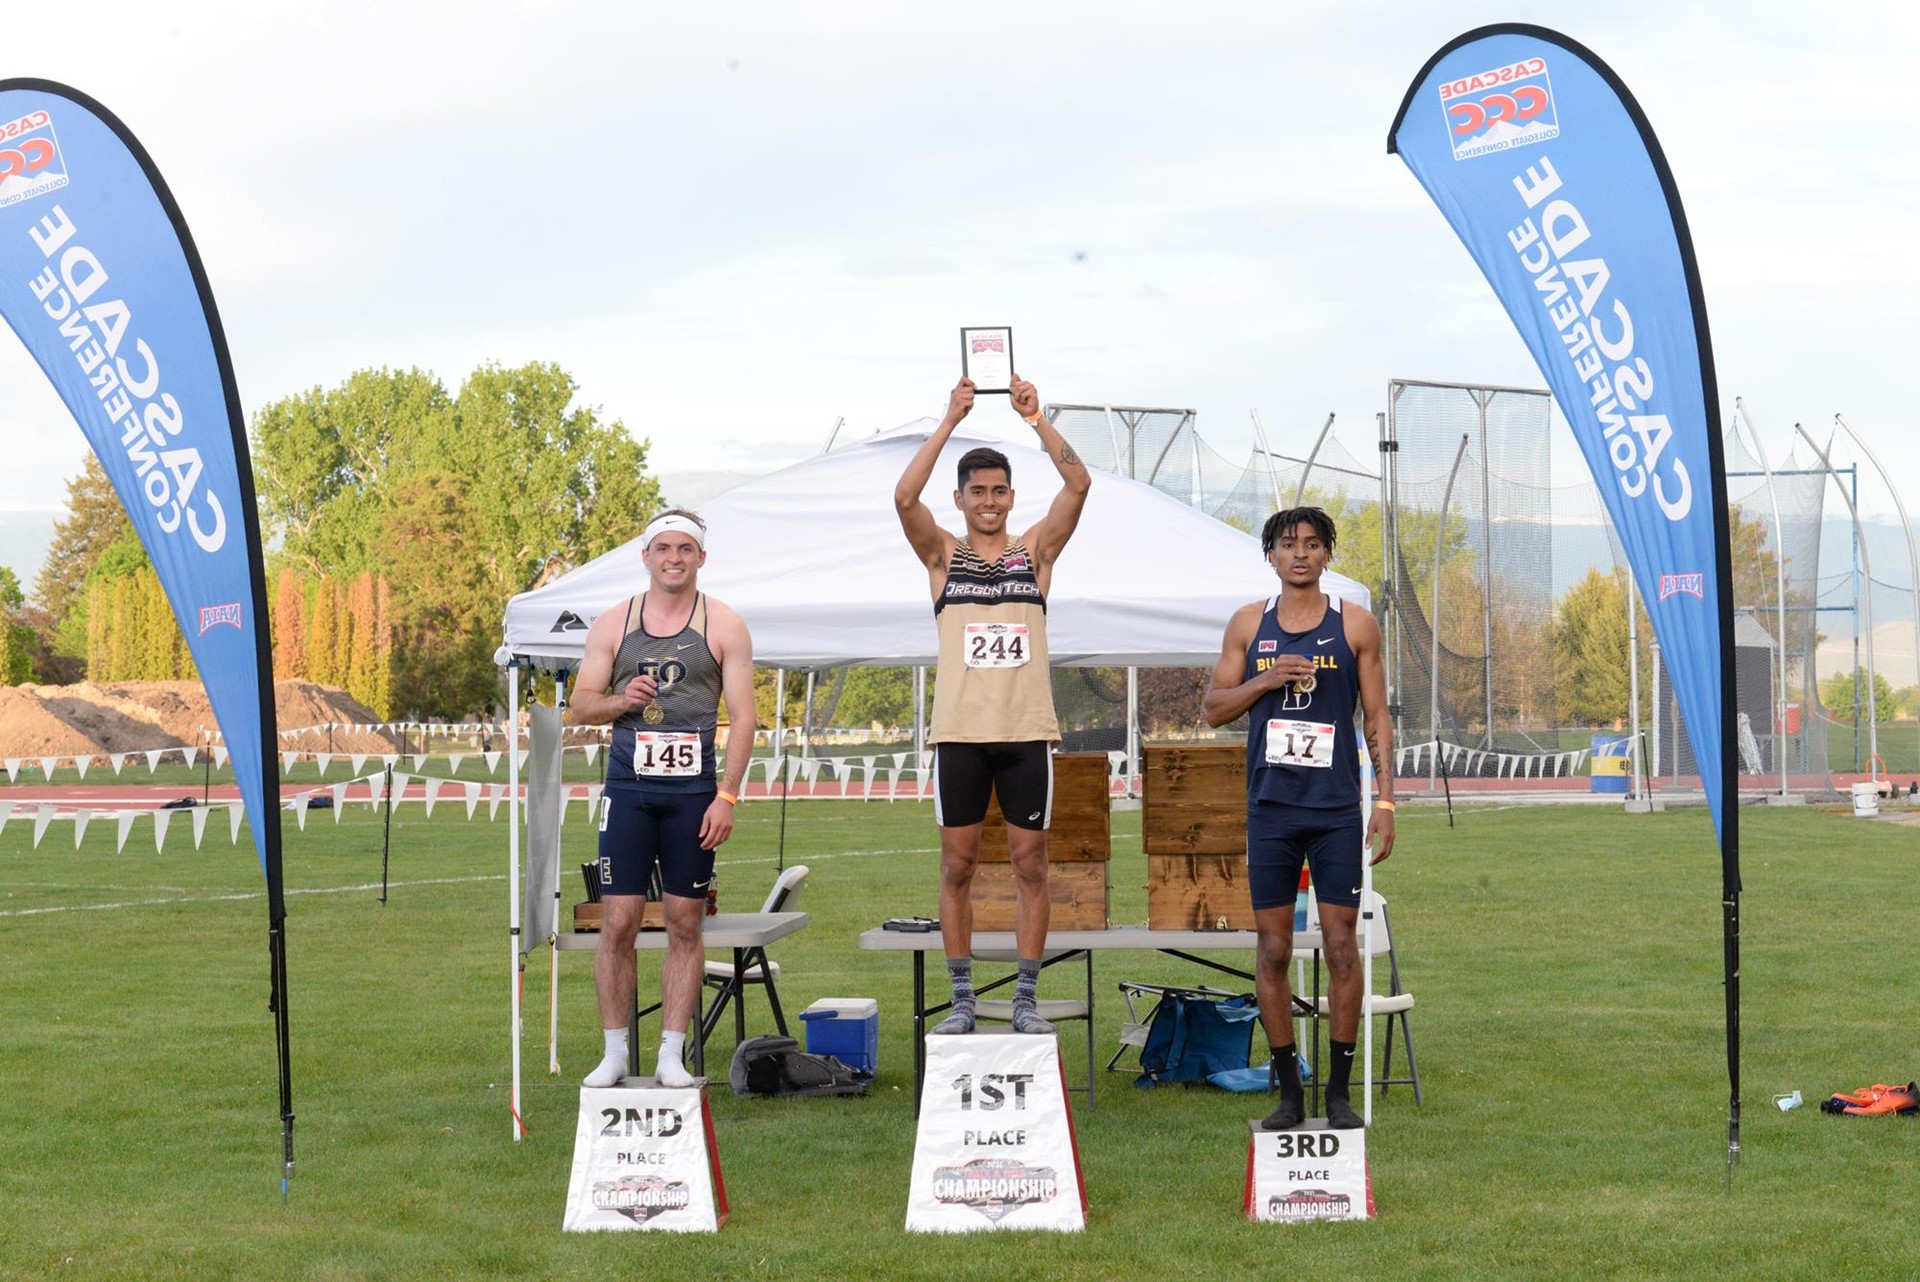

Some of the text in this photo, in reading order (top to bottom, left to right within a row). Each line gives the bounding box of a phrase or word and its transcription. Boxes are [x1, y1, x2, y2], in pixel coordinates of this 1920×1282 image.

[1003, 581, 1039, 596] TECH
[972, 636, 1023, 659] 244
[1256, 655, 1338, 672] BUELL
[1284, 733, 1317, 758] 17
[643, 744, 694, 767] 145
[951, 1073, 1034, 1111] 1ST
[600, 1107, 683, 1138] 2ND
[963, 1129, 1026, 1146] PLACE
[1277, 1133, 1340, 1158] 3RD
[616, 1152, 666, 1165] PLACE
[1288, 1170, 1330, 1181] PLACE
[593, 1189, 688, 1206] CHAMPIONSHIP
[935, 1178, 1055, 1199] CHAMPIONSHIP
[1270, 1202, 1350, 1216] CHAMPIONSHIP
